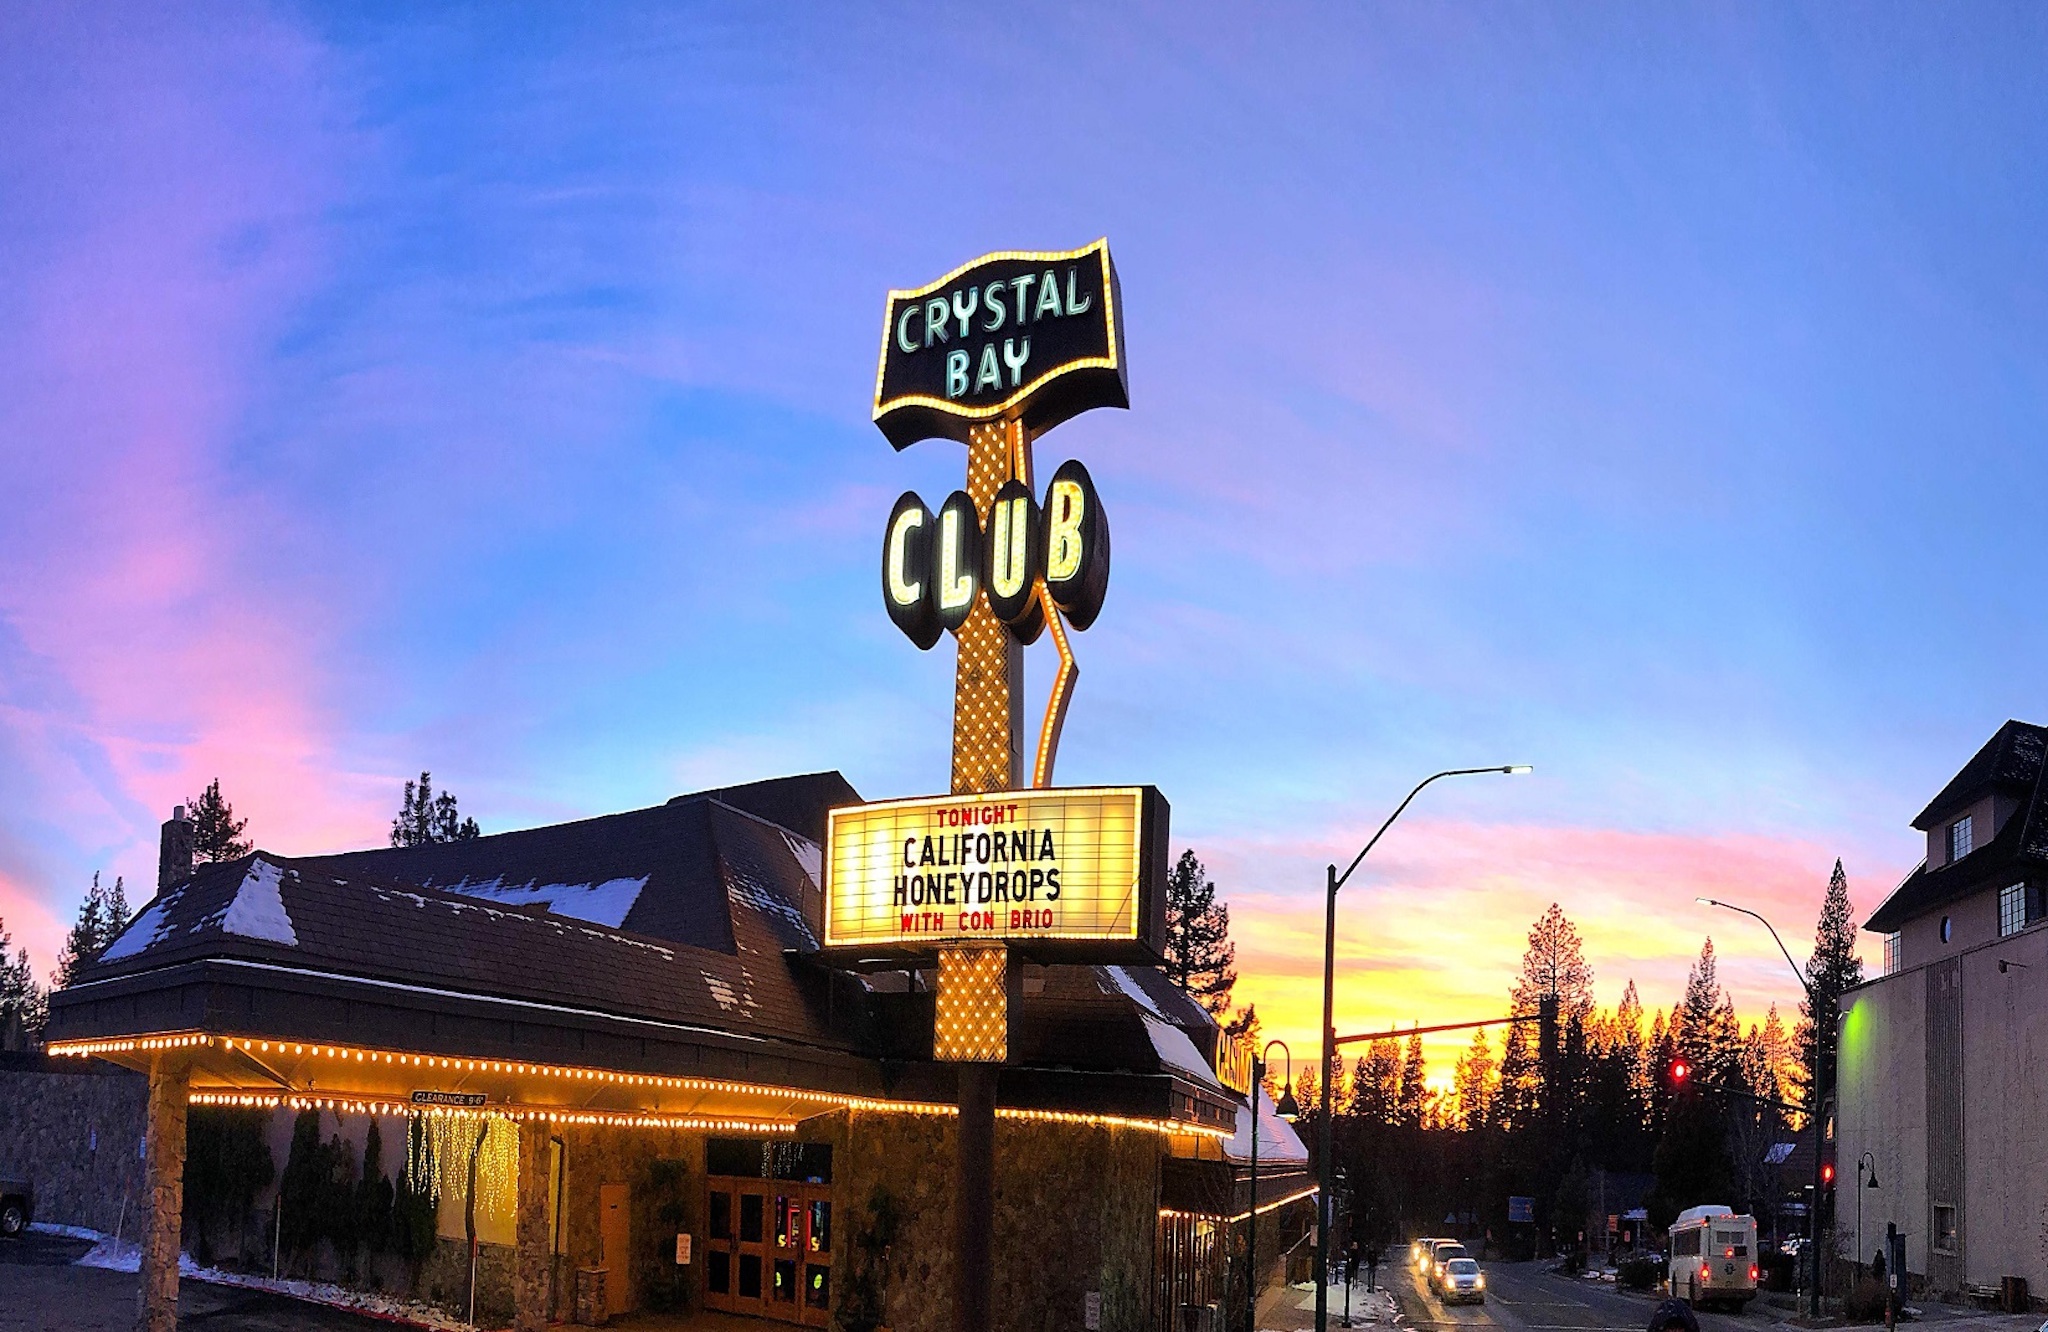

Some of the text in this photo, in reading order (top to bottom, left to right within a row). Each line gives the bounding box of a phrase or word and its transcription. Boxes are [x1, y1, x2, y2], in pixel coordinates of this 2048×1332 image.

[897, 265, 1092, 353] CRYSTAL
[946, 335, 1031, 399] BAY
[889, 481, 1085, 609] CLUB
[937, 804, 1018, 828] TONIGHT
[904, 828, 1055, 868] CALIFORNIA
[893, 868, 1061, 906] HONEYDROPS
[901, 908, 1053, 932] WITH CON BRIO
[1216, 1029, 1253, 1096] CASINO
[415, 1092, 465, 1105] CLEARANCE
